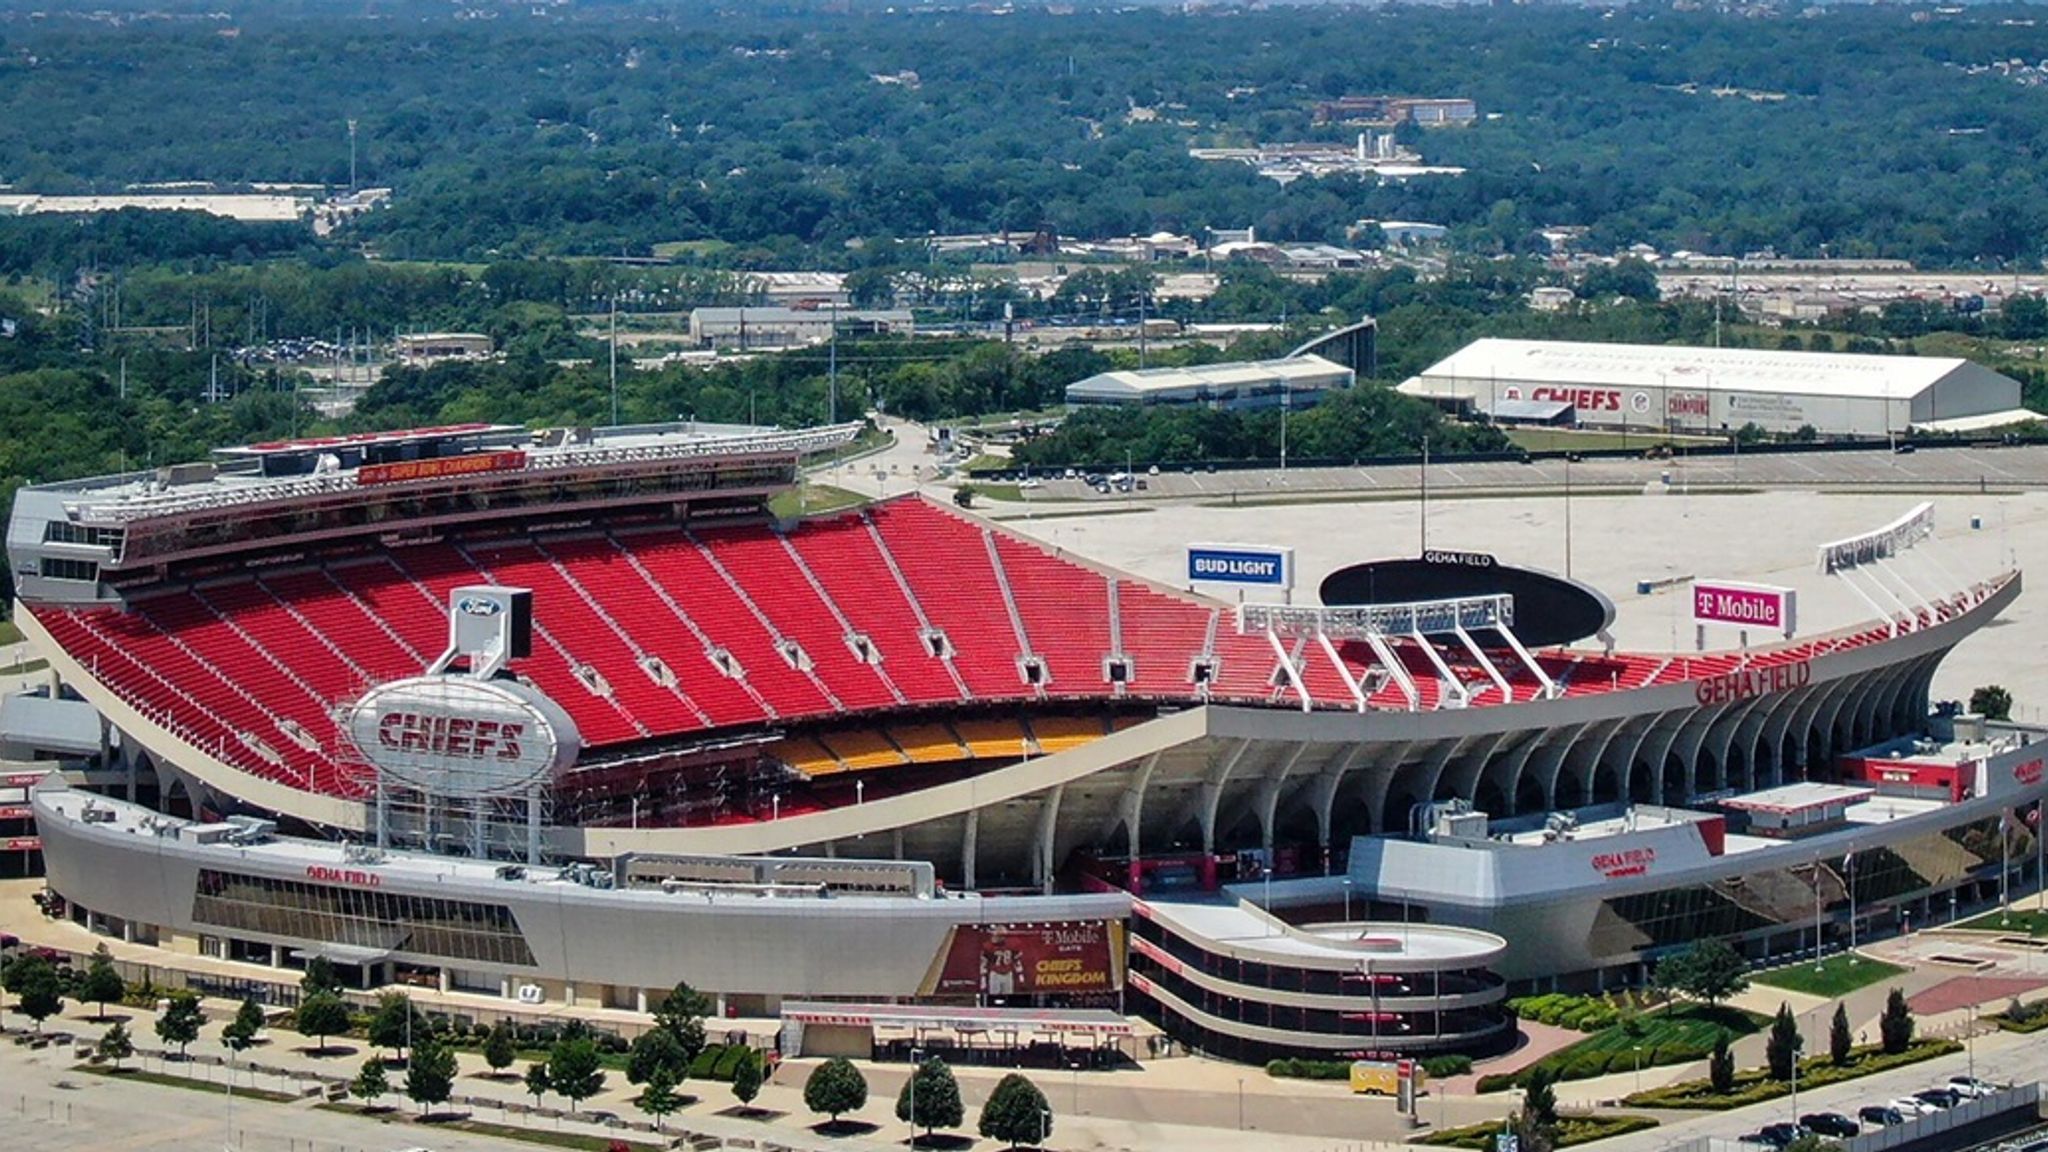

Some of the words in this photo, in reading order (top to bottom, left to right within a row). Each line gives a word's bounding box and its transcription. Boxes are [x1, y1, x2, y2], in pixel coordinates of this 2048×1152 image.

[1532, 387, 1621, 411] CHIEFS
[390, 465, 417, 478] SUPER
[1195, 558, 1228, 573] BUD
[1229, 560, 1275, 576] LIGHT
[1425, 552, 1458, 564] GEHA
[1459, 554, 1490, 567] FIELD
[1717, 594, 1775, 621] Mobile
[1696, 671, 1755, 705] GEHA
[1759, 660, 1810, 696] FIELD
[378, 712, 524, 762] CHIEFS
[306, 865, 343, 882] GEHA
[344, 870, 381, 887] FIELD
[1055, 929, 1099, 945] Mobile
[993, 950, 1012, 967] 78
[1035, 959, 1083, 973] CHIEFS
[1034, 972, 1106, 986] KINGDOM
